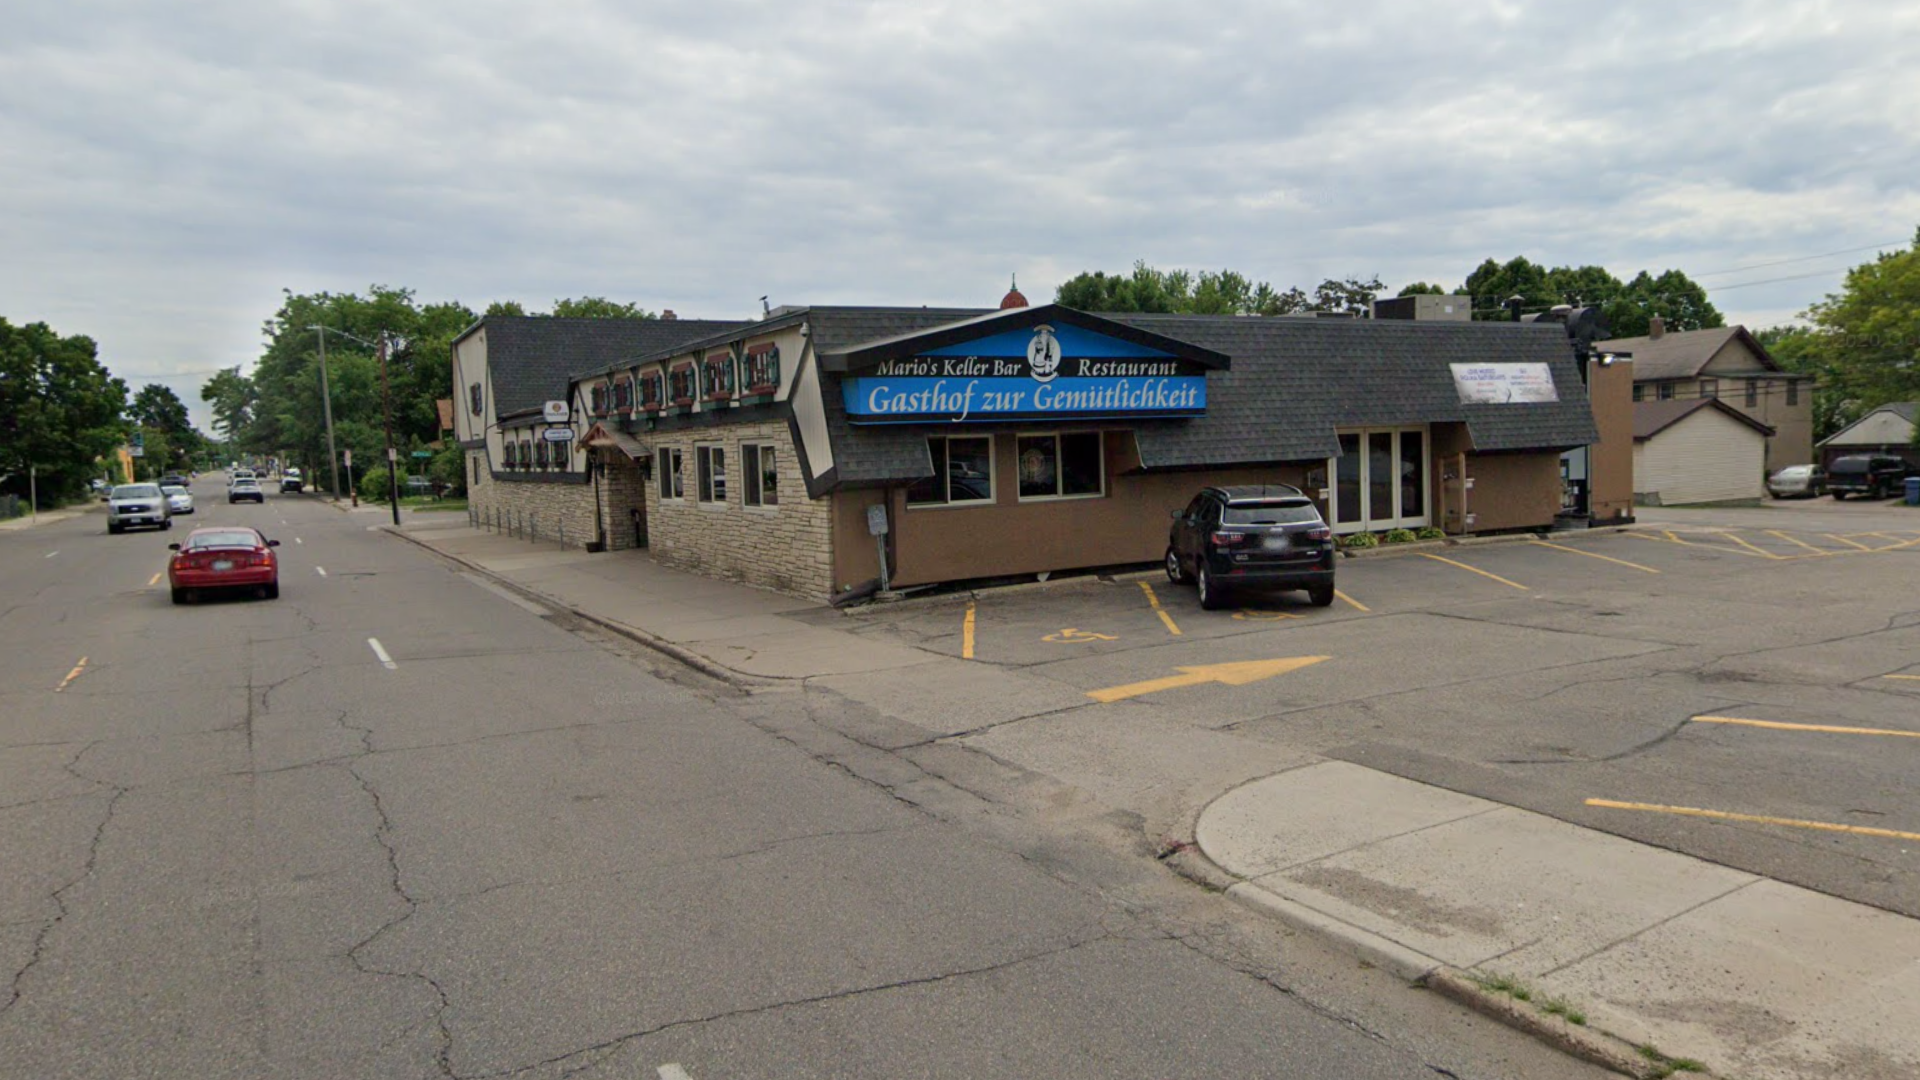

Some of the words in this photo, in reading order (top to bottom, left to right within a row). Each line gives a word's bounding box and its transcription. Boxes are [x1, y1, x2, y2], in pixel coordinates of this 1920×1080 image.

[876, 358, 938, 376] Mario's
[942, 356, 989, 376] Keller
[992, 359, 1022, 376] Bar
[1077, 358, 1178, 377] Restaurant
[868, 380, 979, 422] Gasthof
[981, 391, 1025, 411] zur
[1033, 378, 1198, 410] Gemütlichkeit
